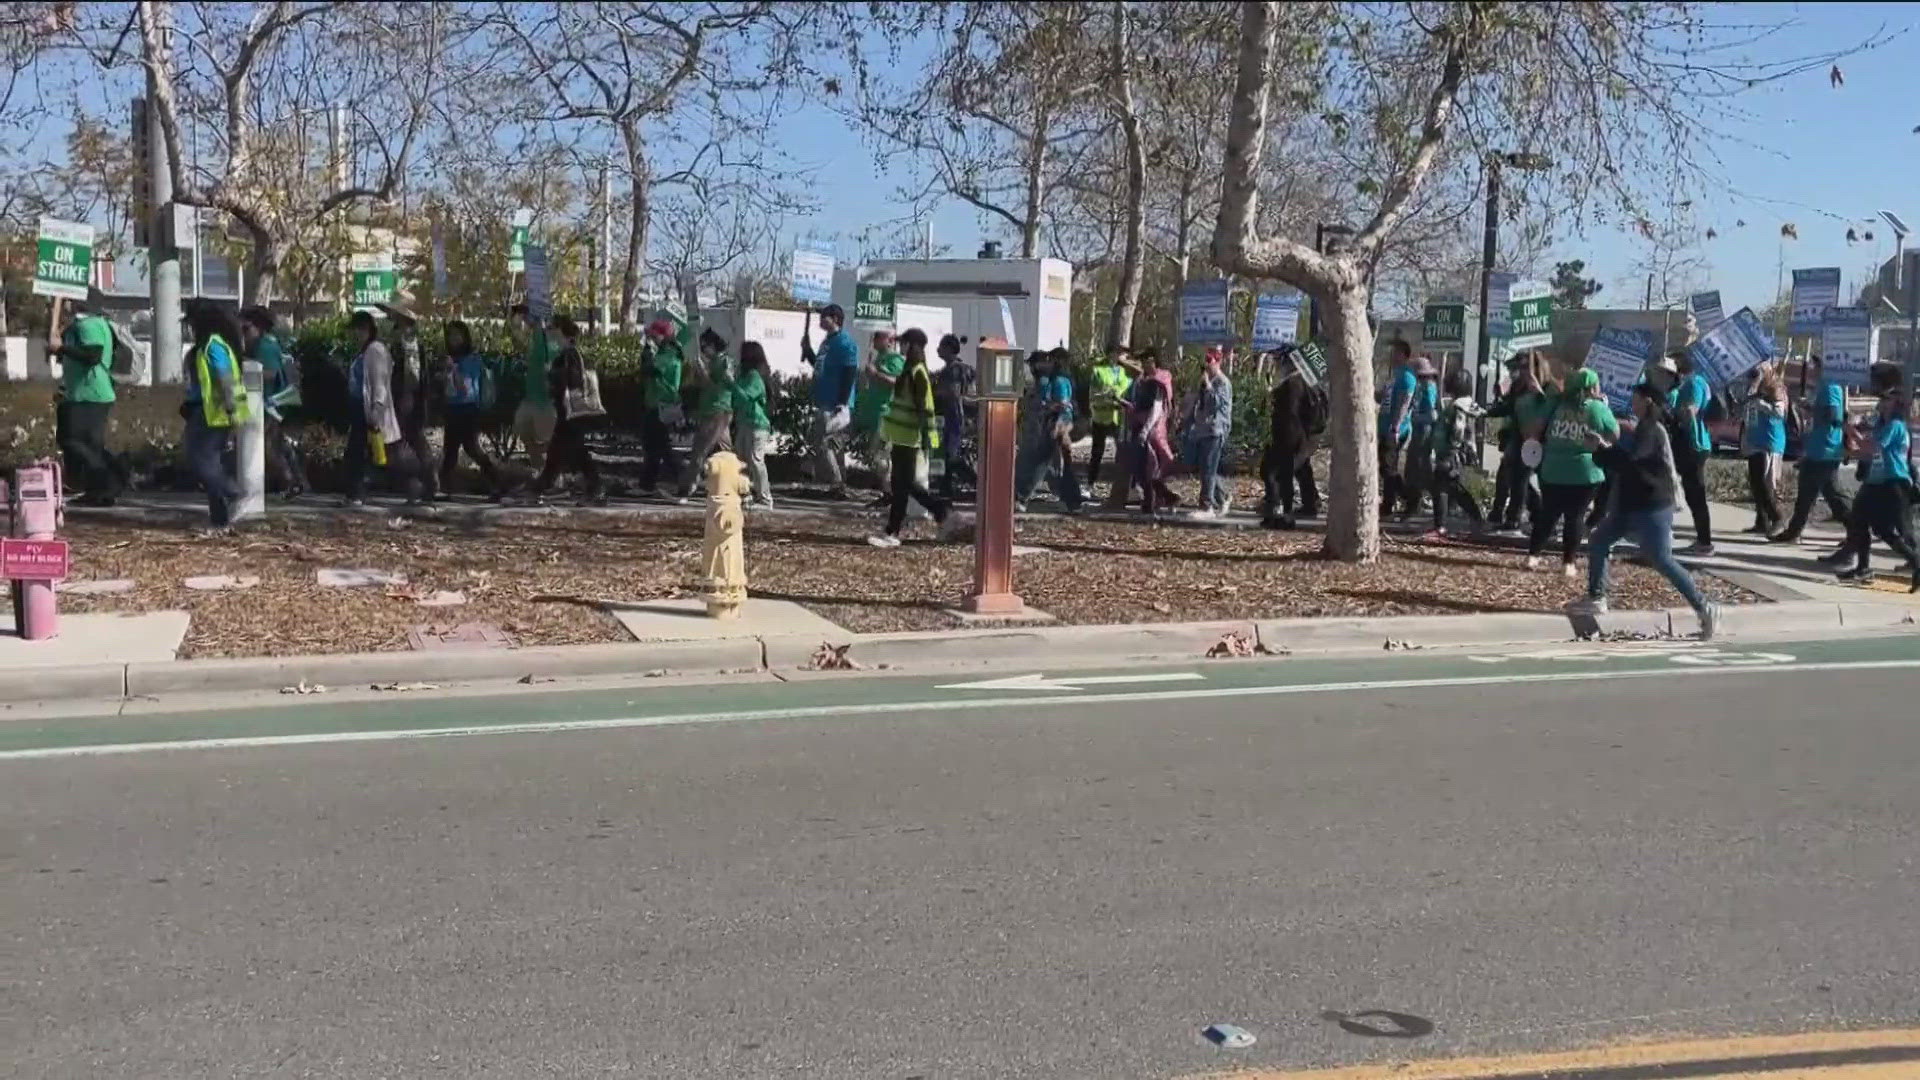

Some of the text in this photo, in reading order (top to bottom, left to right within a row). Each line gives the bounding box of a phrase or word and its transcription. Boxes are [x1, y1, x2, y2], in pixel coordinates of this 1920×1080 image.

[55, 245, 74, 263] ON
[38, 259, 87, 282] STRIKE
[366, 274, 380, 289] ON
[355, 288, 391, 304] STRIKE
[868, 288, 882, 301] ON
[857, 302, 891, 318] STRIKE
[1436, 308, 1451, 321] ON
[1523, 302, 1538, 316] ON
[1424, 323, 1460, 338] STRIKE
[1513, 315, 1549, 333] STRIKE
